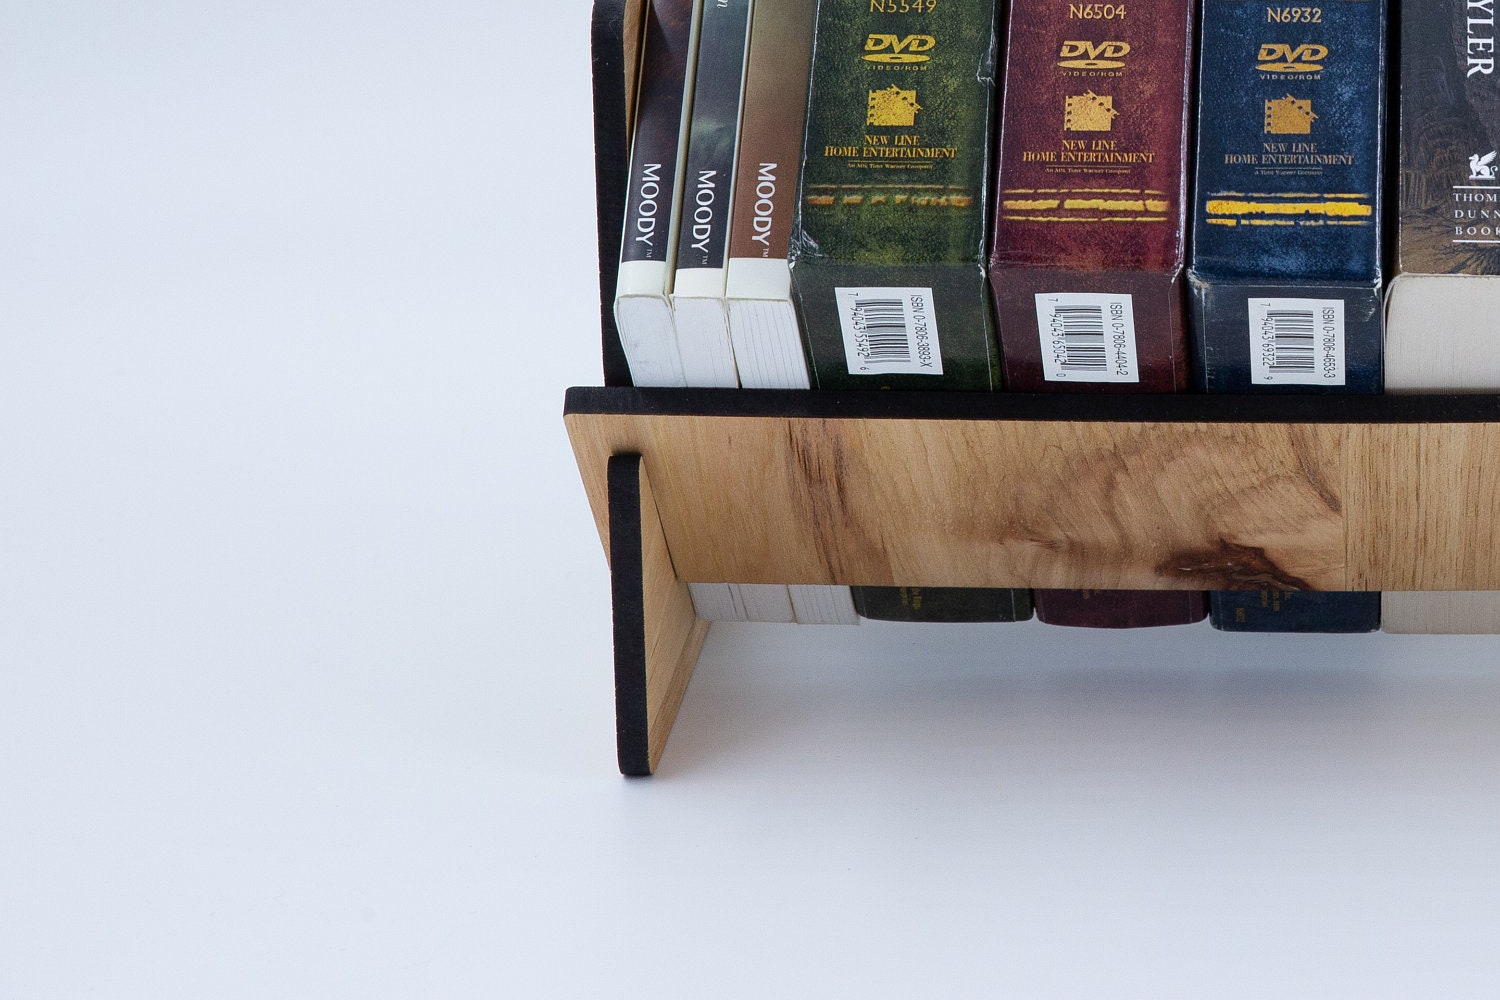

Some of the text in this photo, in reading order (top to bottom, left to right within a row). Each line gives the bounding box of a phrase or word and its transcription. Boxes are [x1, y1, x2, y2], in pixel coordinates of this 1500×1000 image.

[1069, 4, 1126, 20] N6504
[1267, 7, 1322, 23] N6932
[864, 34, 936, 54] DVD
[1060, 41, 1131, 60] DVD
[1257, 44, 1329, 63] DVD
[864, 135, 920, 146] NEW LINE
[1062, 140, 1118, 150] NEW LINE
[1263, 143, 1317, 153] NEW LINE
[824, 146, 957, 159] HOME ENTERTAINMENT
[1022, 151, 1155, 164] HOME ENTERTAINMENT
[1224, 154, 1354, 166] HOME ENTERTAINMENT
[850, 307, 866, 331] 94043
[1050, 313, 1065, 337] 94043
[910, 294, 932, 367] ISBN 0-7806-3893-X
[1110, 302, 1129, 376] ISBN 0-7806-4404-2
[1261, 318, 1274, 341] 94043
[855, 334, 870, 357] 55492
[1052, 341, 1067, 364] 65042
[1322, 307, 1336, 379] ISBN 0-7806-4653-3
[1262, 343, 1275, 367] 69322
